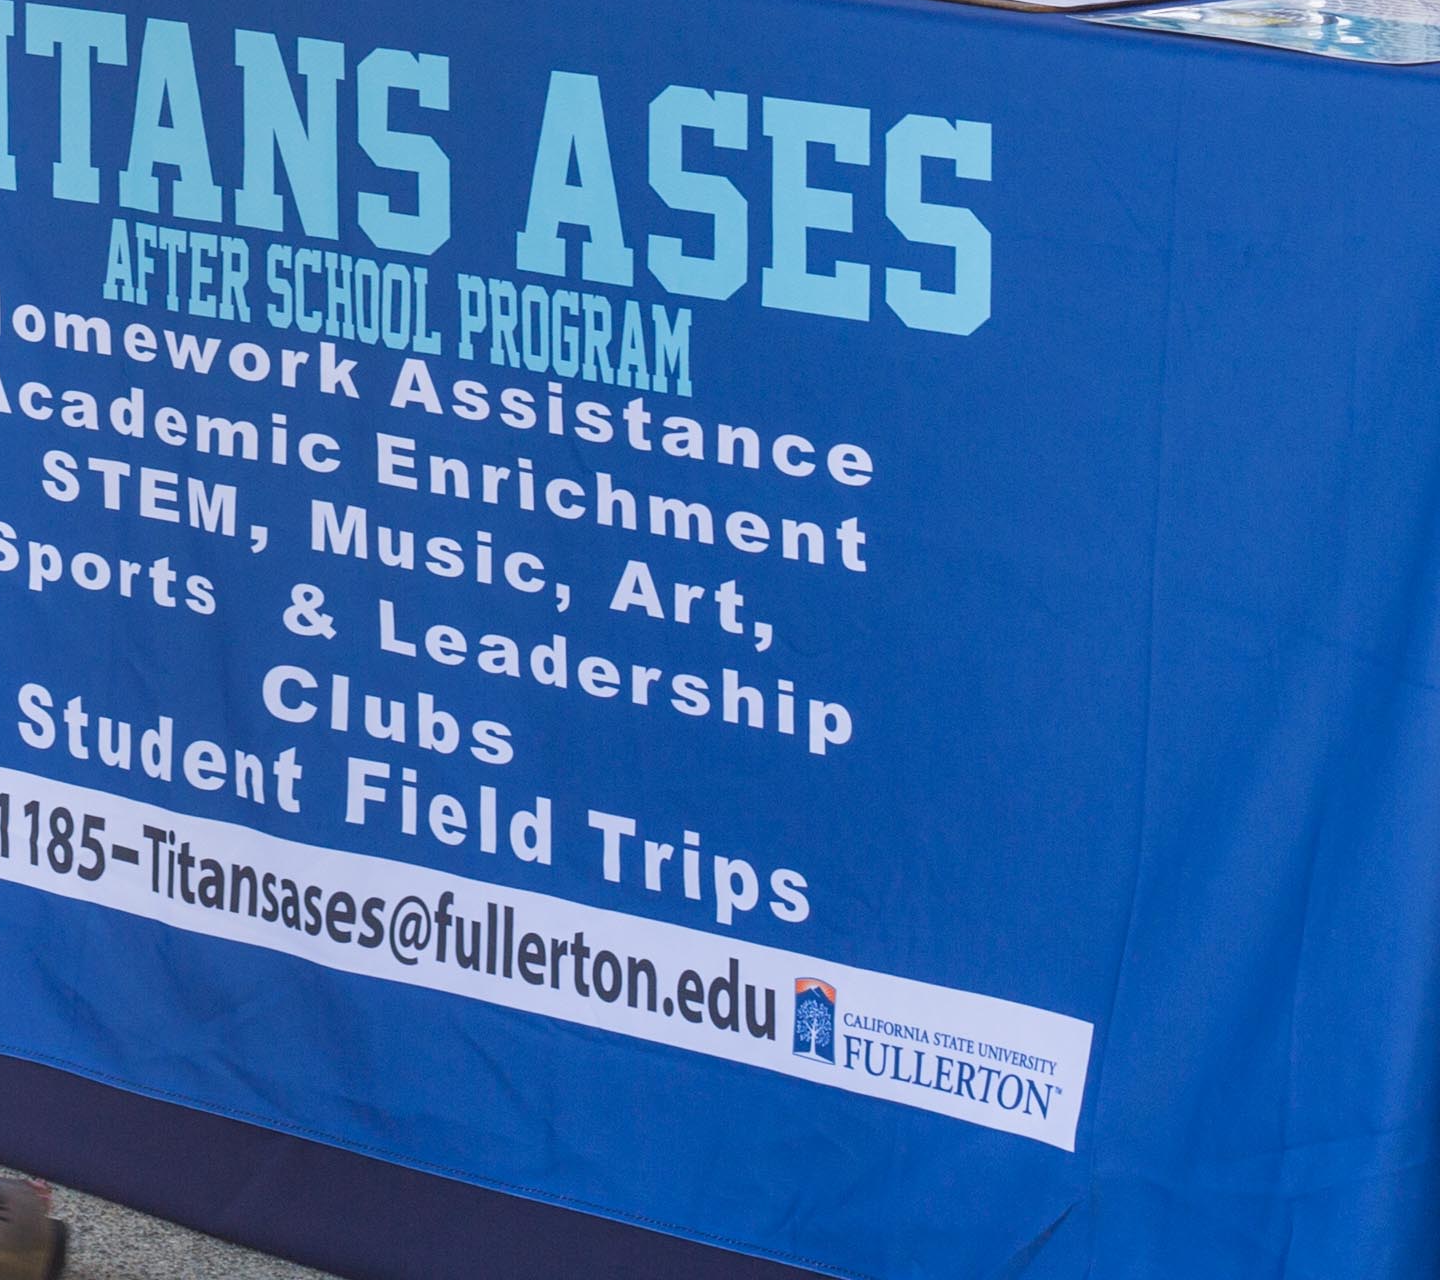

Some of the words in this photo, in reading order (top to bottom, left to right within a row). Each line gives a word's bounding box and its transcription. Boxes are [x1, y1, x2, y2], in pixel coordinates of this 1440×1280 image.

[516, 69, 992, 337] ASES
[102, 218, 247, 318] AFTER
[265, 244, 442, 357] SCHOOL
[458, 271, 692, 398] PROGRAM
[389, 359, 875, 488] Assistance
[40, 449, 270, 555] STEM,
[310, 497, 572, 614] Music,
[608, 556, 776, 652] Art,
[376, 432, 868, 574] Enrichment
[261, 664, 515, 766] Clubs
[282, 583, 339, 640] &
[378, 596, 855, 758] Leadership
[17, 682, 303, 816] Student
[346, 756, 556, 865] Field
[587, 808, 813, 928] Trips
[843, 1012, 929, 1044] CALIFORNIA
[933, 1032, 974, 1055] STATE
[978, 1043, 1058, 1076] UNIVERSITY
[843, 1034, 1054, 1120] FULLERTON
